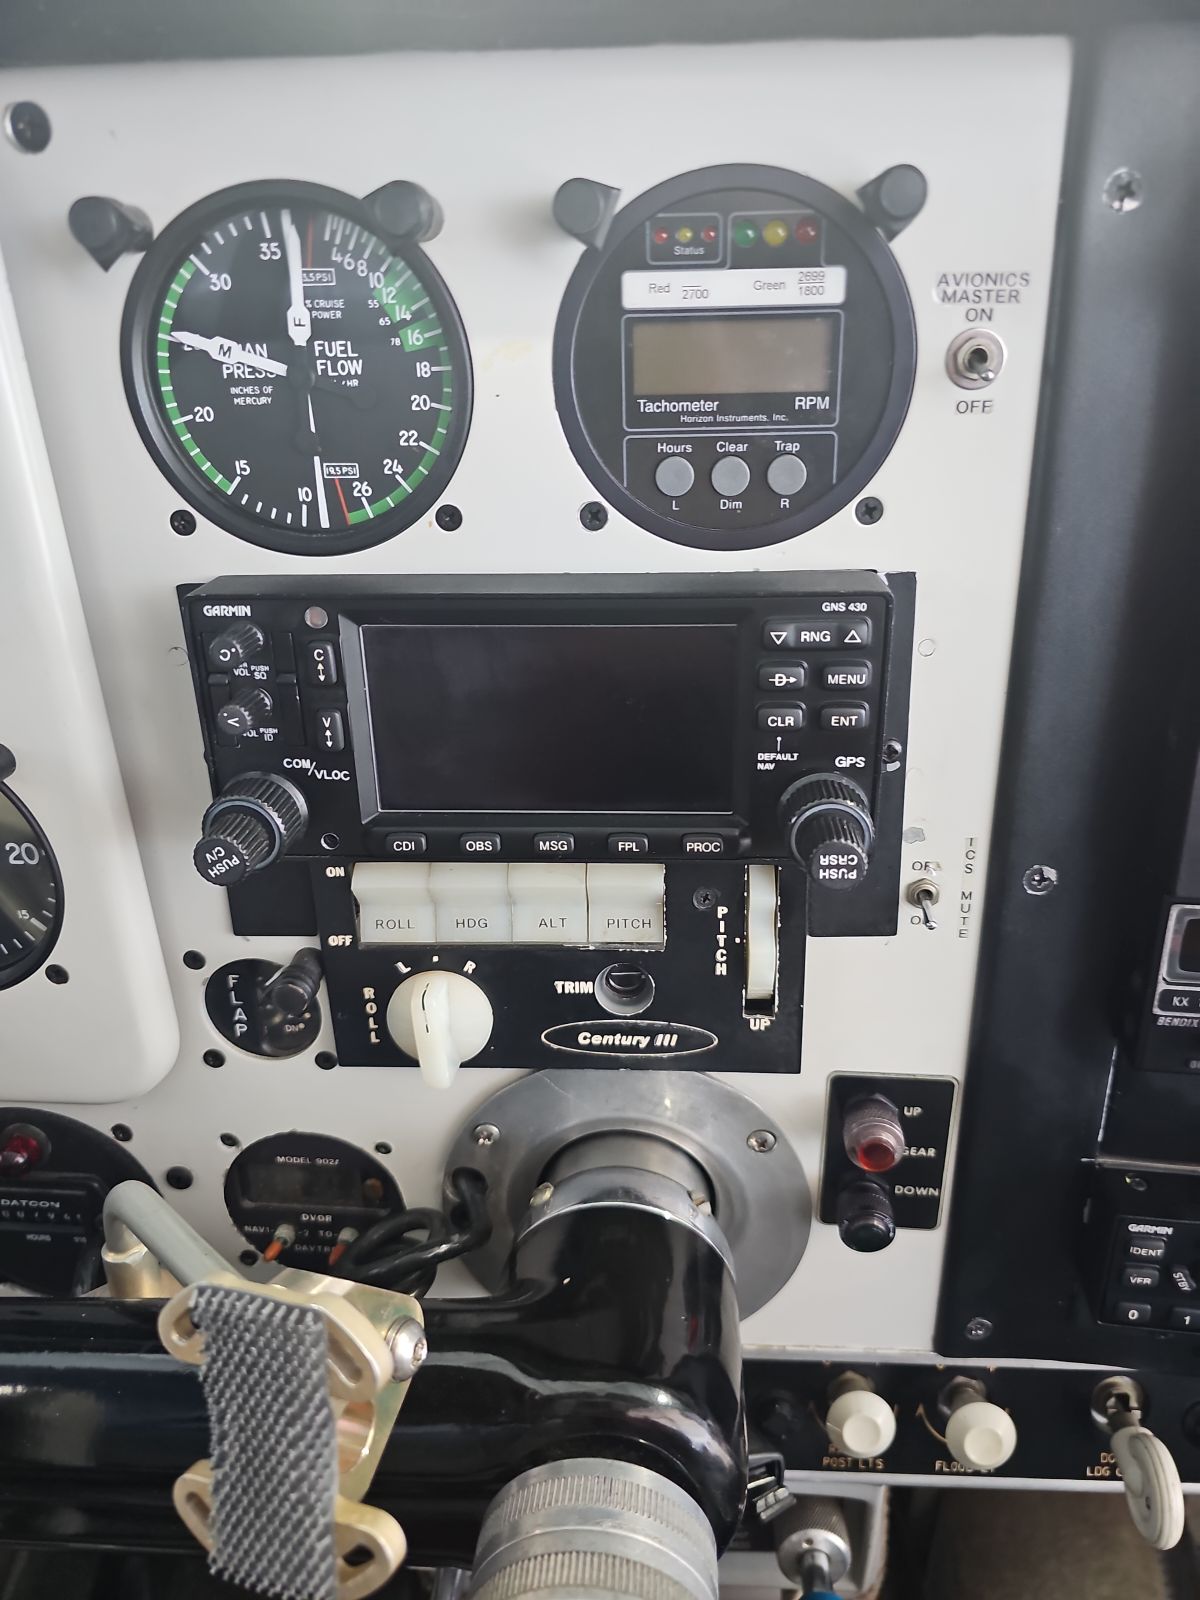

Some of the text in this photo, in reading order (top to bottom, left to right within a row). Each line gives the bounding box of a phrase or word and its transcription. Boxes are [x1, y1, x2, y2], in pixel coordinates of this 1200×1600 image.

[259, 243, 281, 260] 35
[331, 246, 343, 263] 4
[674, 246, 705, 255] Status
[343, 253, 355, 270] 6
[357, 260, 368, 277] 8
[209, 273, 231, 291] 30
[369, 272, 384, 289] 10
[798, 270, 825, 282] 2699
[937, 272, 1030, 288] AVIONICS
[649, 283, 671, 294] Red
[753, 280, 786, 291] Green
[799, 285, 825, 296] 1800
[382, 287, 397, 304] 12
[682, 289, 709, 300] 2700
[941, 289, 1021, 304] MASTER
[314, 299, 345, 308] CRUISE
[368, 300, 380, 309] 55
[312, 311, 342, 319] POWER
[395, 305, 412, 321] 14
[965, 308, 993, 322] ON
[379, 317, 392, 326] 65
[407, 329, 424, 345] 16
[314, 340, 359, 357] FUEL
[316, 359, 363, 376] FLOW
[416, 362, 431, 377] 18
[230, 386, 274, 395] INCHES OF
[233, 397, 272, 406] MERCURY
[411, 396, 431, 410] 20
[637, 396, 830, 414] Tachometer RPM
[956, 400, 993, 414] OFF
[194, 406, 214, 422] 20
[680, 415, 714, 424] Horizon
[399, 431, 419, 446] 22
[657, 441, 693, 453] Hours
[716, 441, 748, 452] Clear
[774, 441, 801, 454] Trap
[235, 460, 250, 475] 15
[383, 459, 404, 474] 24
[298, 487, 312, 502] 10
[352, 481, 373, 497] 26
[672, 500, 679, 510] L
[720, 499, 742, 510] Dim
[780, 498, 790, 509] R
[203, 605, 251, 617] GARMIN
[822, 602, 868, 612] GNS 430
[801, 631, 831, 643] RNG
[314, 649, 324, 661] C
[233, 668, 251, 677] VOL
[827, 674, 866, 685] MENU
[322, 717, 331, 728] V
[767, 716, 794, 727] CLR
[831, 715, 858, 726] ENT
[757, 752, 799, 761] DEFAULT
[834, 756, 866, 768] GPS
[757, 762, 776, 770] NAV
[393, 841, 415, 852] CDI
[465, 841, 492, 851] OBS
[539, 840, 568, 851] MSG
[618, 841, 639, 852] FPL
[686, 842, 720, 853] PROC
[5, 842, 39, 865] 20
[207, 854, 240, 878] PUSH
[819, 854, 858, 866] CRSR
[325, 866, 345, 878] ON
[819, 869, 857, 880] PUSH
[958, 891, 972, 938] MUTE
[375, 919, 415, 930] ROLL
[455, 918, 488, 929] HDG
[538, 917, 567, 929] ALT
[606, 918, 651, 929] PITCH
[327, 935, 353, 947] OFF
[715, 906, 729, 976] PITCH
[463, 960, 477, 974] R
[554, 980, 593, 994] TRIM
[227, 974, 248, 1037] FLAP
[1172, 996, 1189, 1007] KX
[749, 1018, 771, 1031] UP
[1156, 1017, 1199, 1028] BENDIX
[577, 1031, 650, 1048] Century
[903, 1106, 923, 1117] UP
[276, 1155, 311, 1164] MODEL
[894, 1185, 939, 1196] DOWN
[1, 1199, 60, 1208] DATCON
[1127, 1223, 1174, 1235] GARMIN
[1129, 1246, 1163, 1257] IDENT
[1129, 1276, 1152, 1286] VFR
[1172, 1272, 1192, 1292] STBY
[1128, 1309, 1139, 1320] 0
[1184, 1315, 1191, 1326] 1
[822, 1456, 852, 1468] POST
